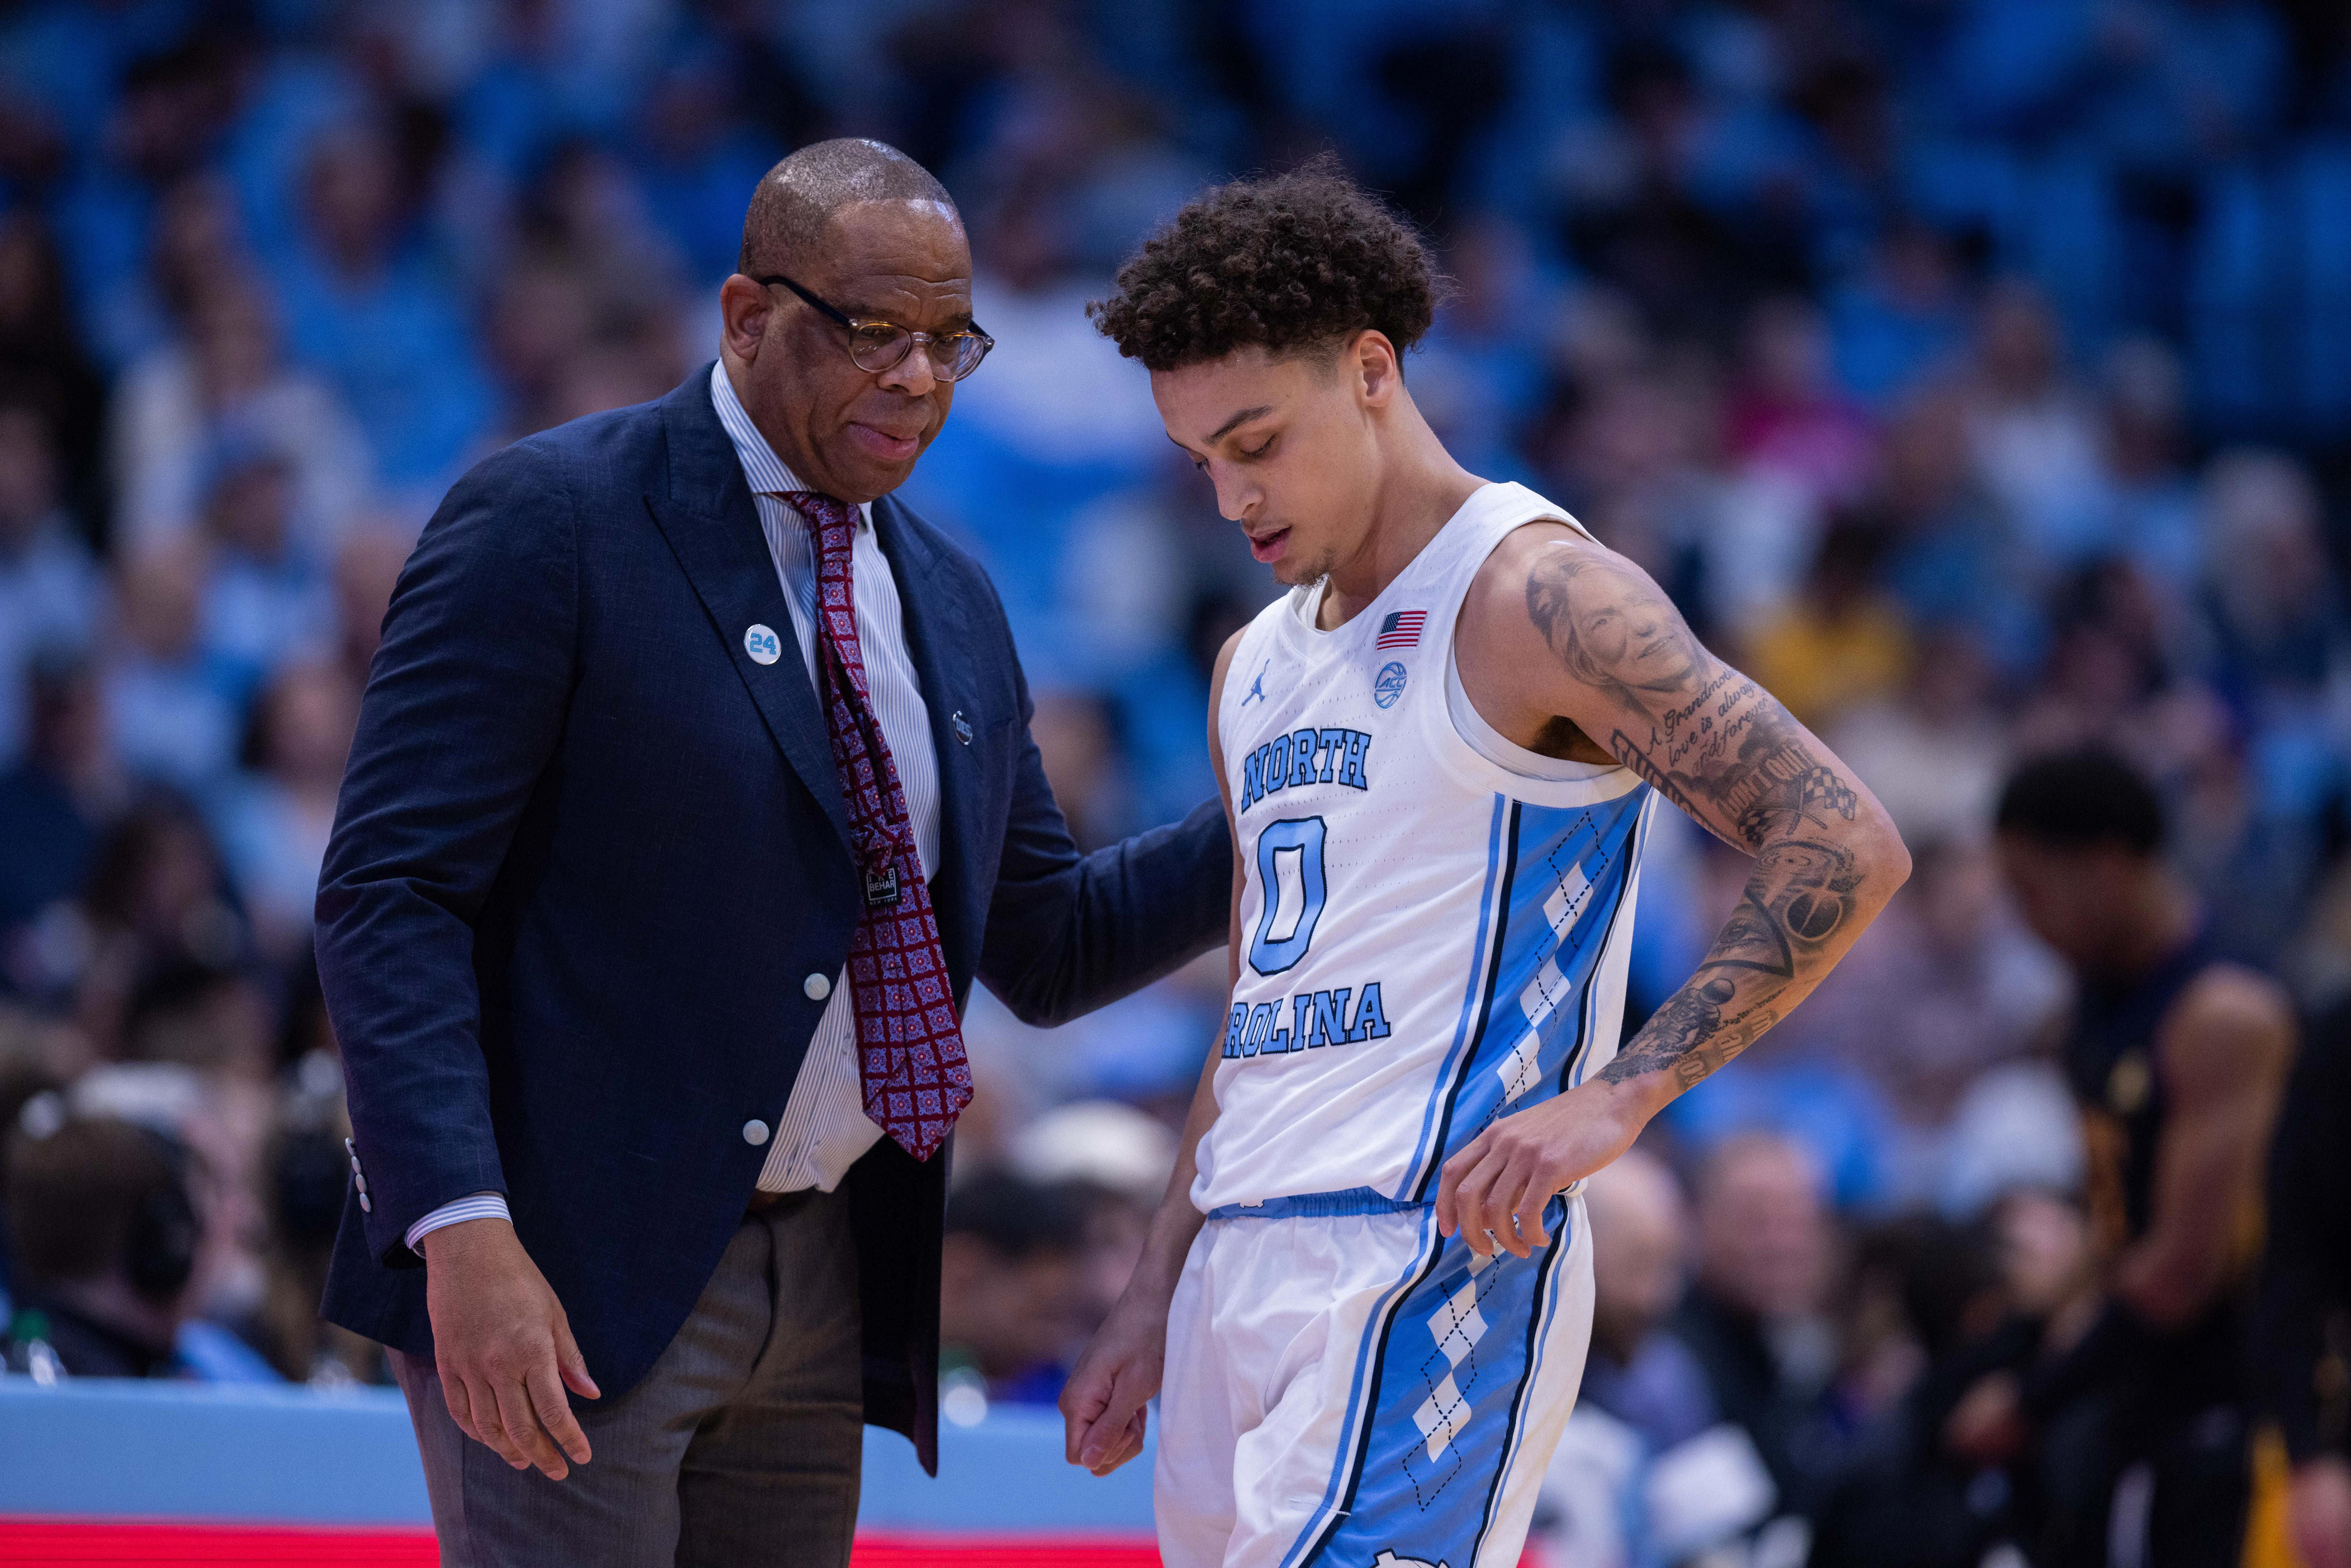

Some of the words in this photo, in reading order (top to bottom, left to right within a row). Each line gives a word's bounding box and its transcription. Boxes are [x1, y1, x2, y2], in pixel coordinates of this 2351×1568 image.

[750, 633, 776, 655] 24
[1379, 676, 1407, 688] ACC
[1668, 732, 1698, 768] love
[1701, 716, 1713, 734] is
[1241, 728, 1372, 815] NORTH
[869, 880, 895, 892] BEHAR
[1248, 815, 1327, 977] 0
[1222, 982, 1391, 1059] ROLINA
